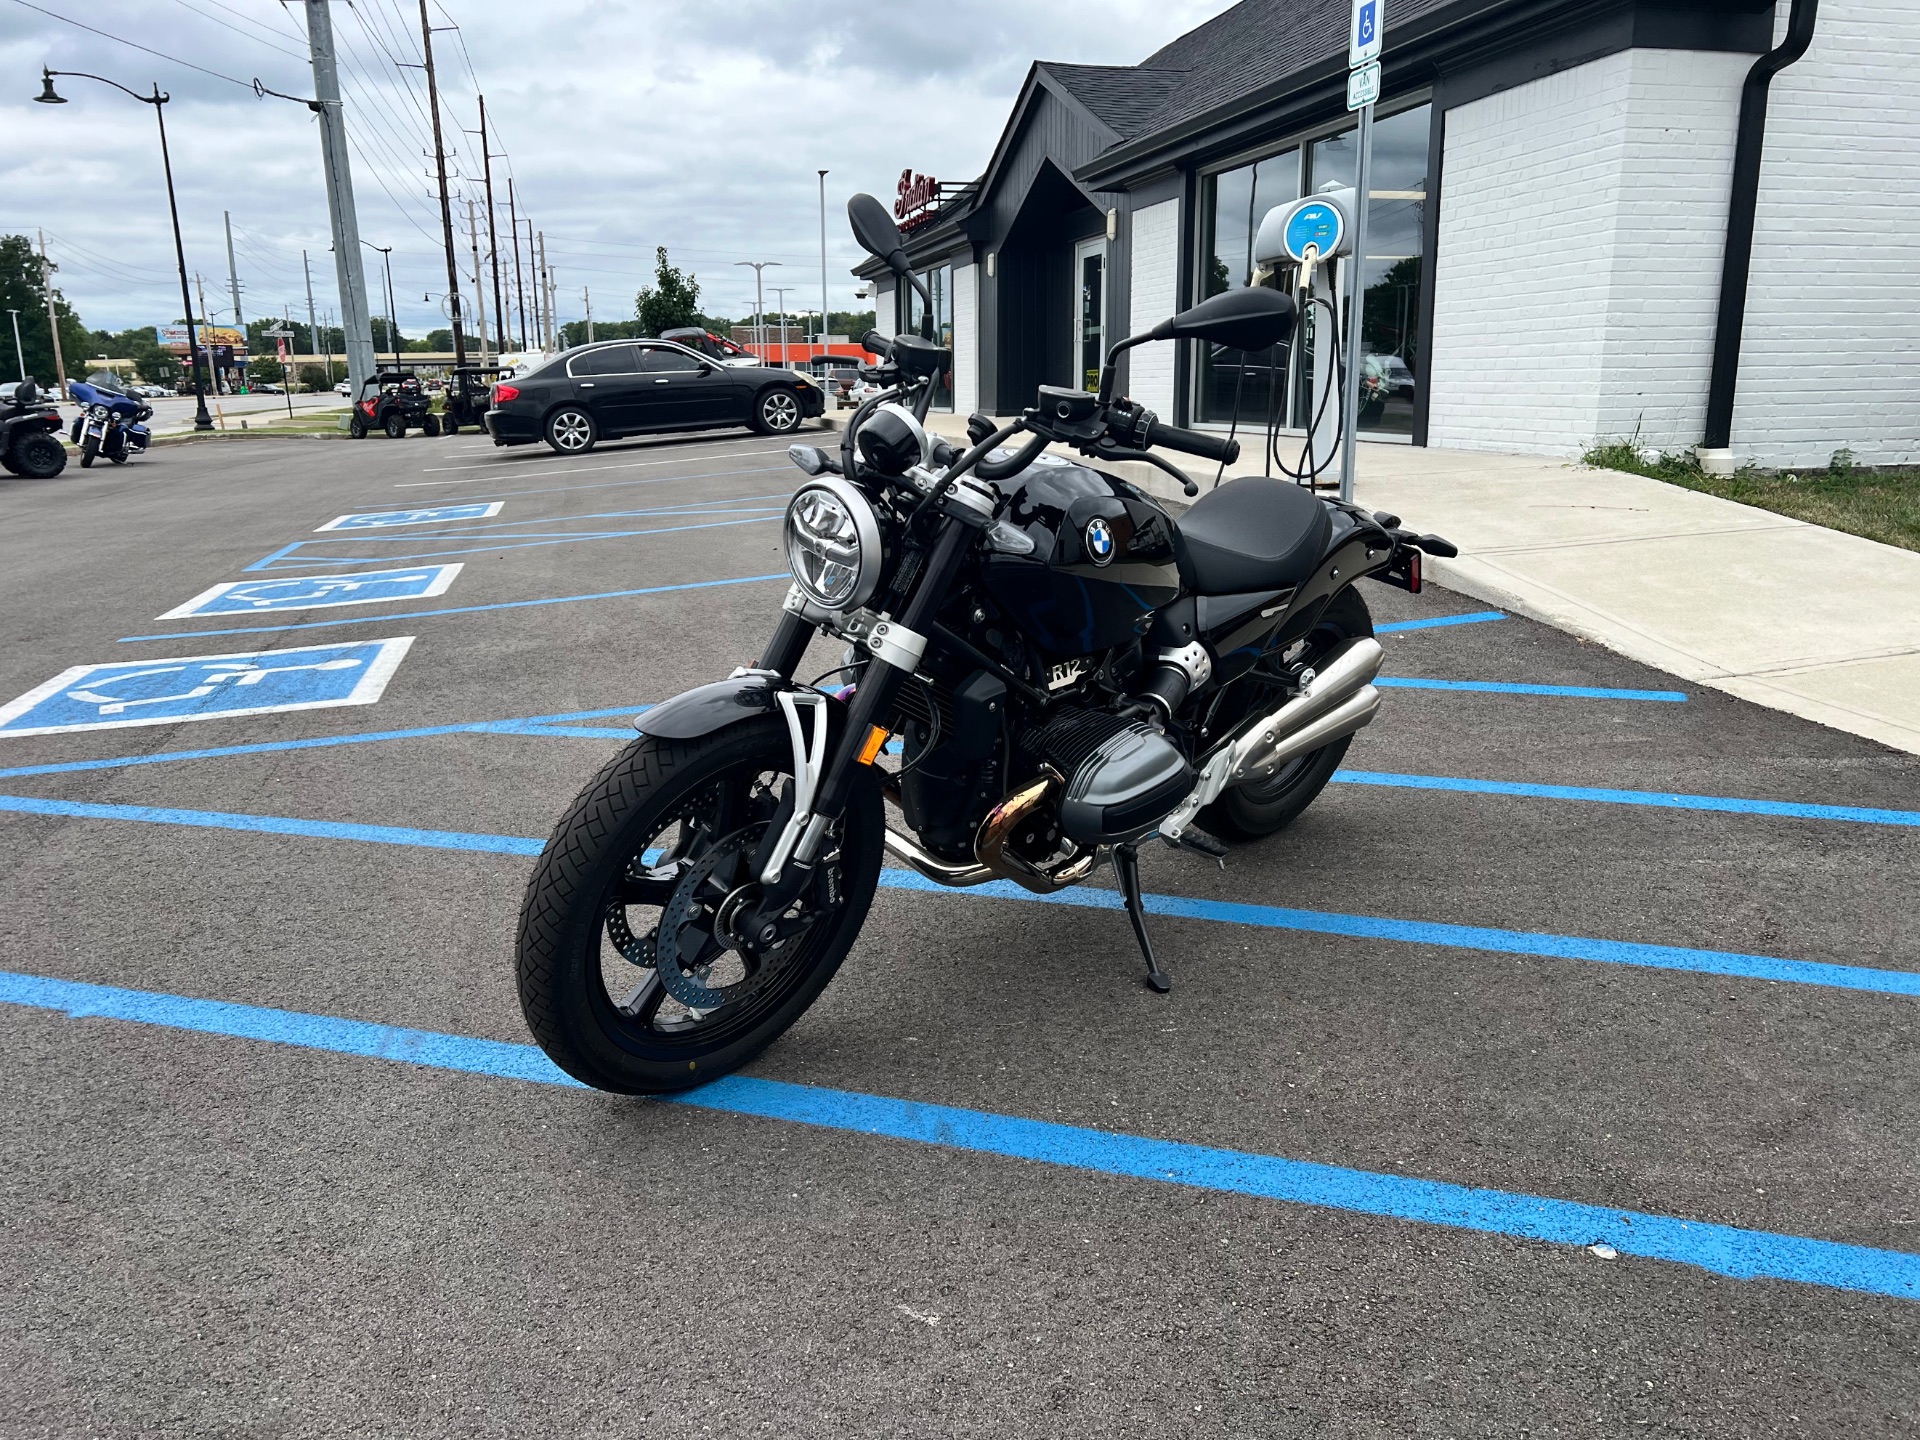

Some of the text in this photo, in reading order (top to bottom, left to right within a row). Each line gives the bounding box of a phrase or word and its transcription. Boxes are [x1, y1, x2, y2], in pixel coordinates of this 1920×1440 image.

[1359, 75, 1370, 88] VAN
[894, 168, 935, 219] Indian
[1089, 521, 1111, 535] BMW
[1052, 660, 1081, 682] R12
[828, 866, 836, 904] brembo
